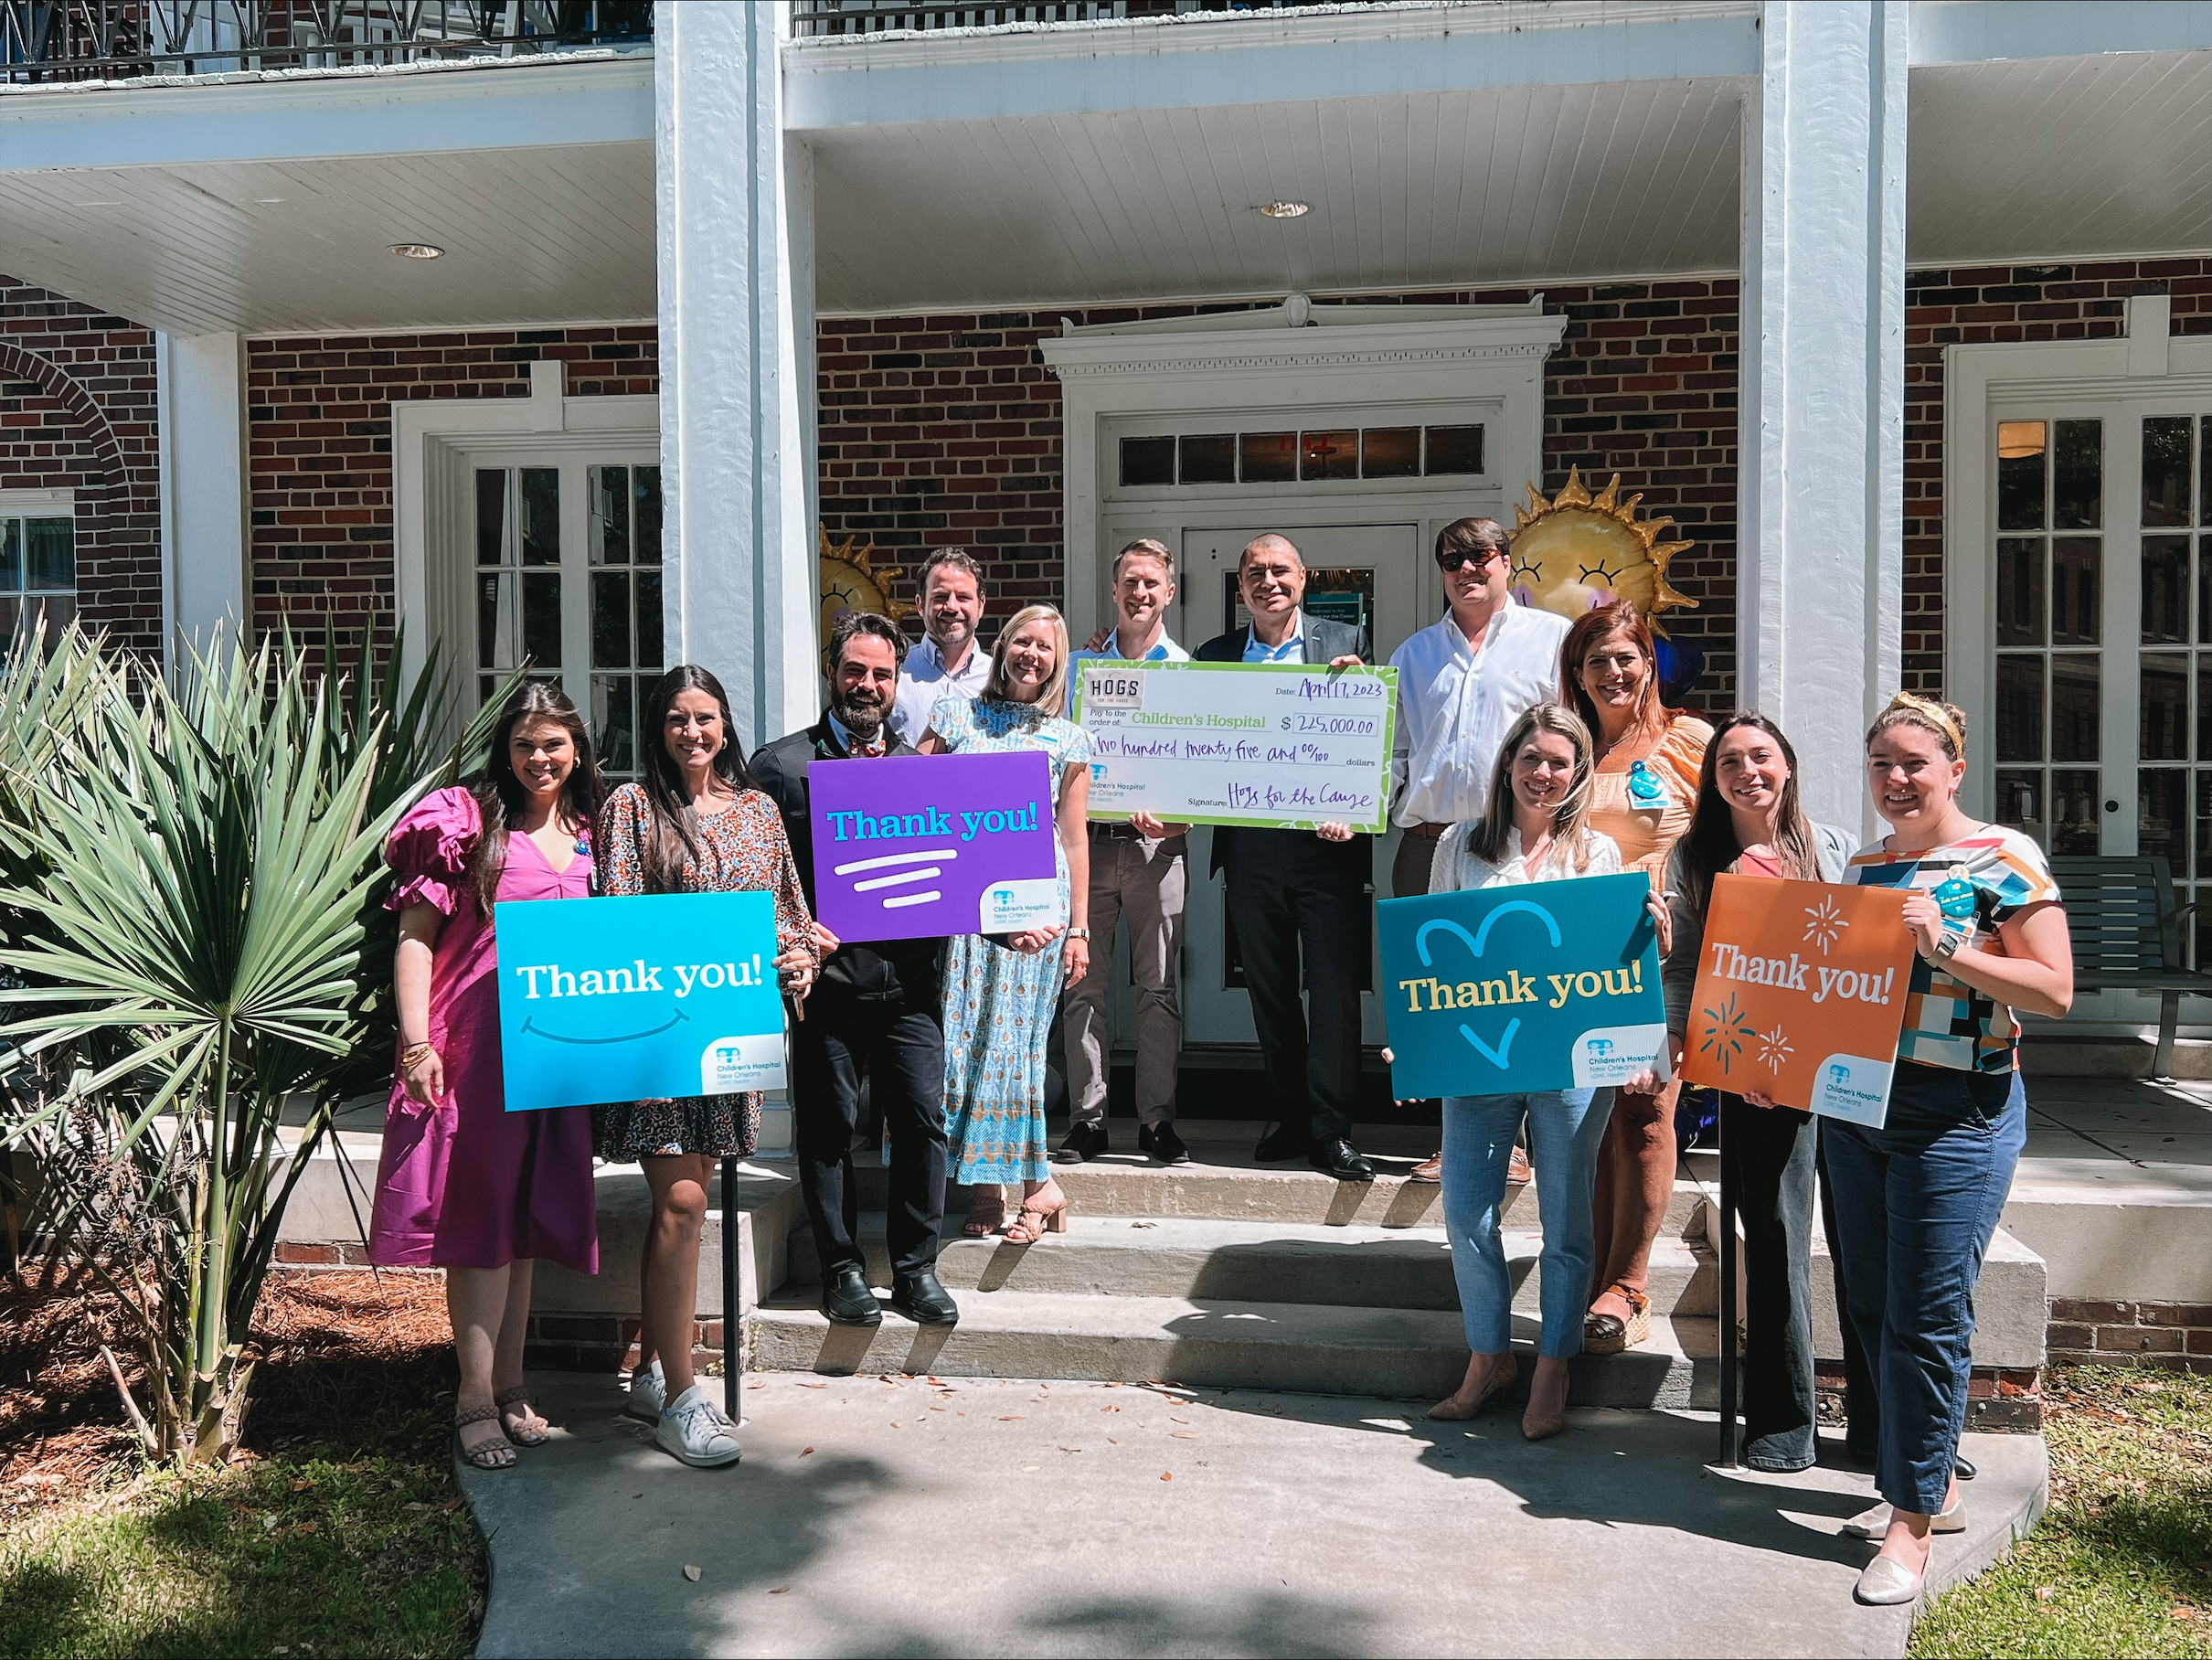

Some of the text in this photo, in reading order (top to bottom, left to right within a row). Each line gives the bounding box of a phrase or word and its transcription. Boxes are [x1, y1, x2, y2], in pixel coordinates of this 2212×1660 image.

[1090, 680, 1139, 697] HOGS
[1299, 677, 1382, 702] April 17, 2023
[1090, 709, 1104, 718] Pay
[1132, 712, 1266, 729] Children's Hospital
[1281, 716, 1292, 730] $
[1122, 734, 1176, 757] hundred
[1185, 740, 1231, 762] twenty
[1235, 740, 1261, 761] five
[1267, 746, 1296, 762] and
[1187, 797, 1228, 808] Signature:
[1228, 782, 1373, 810] Hogs for the Cause
[826, 801, 1038, 841] Thank you!
[1025, 903, 1049, 911] Hospital
[516, 952, 762, 999] Thank you!
[1711, 942, 1894, 1006] Thank you!
[1399, 959, 1643, 1013] Thank you!
[753, 1061, 781, 1069] Hospital
[1589, 1054, 1659, 1065] Children's Hospital
[1824, 1092, 1862, 1107] New Orleans
[1826, 1084, 1883, 1102] Children's Hospital
